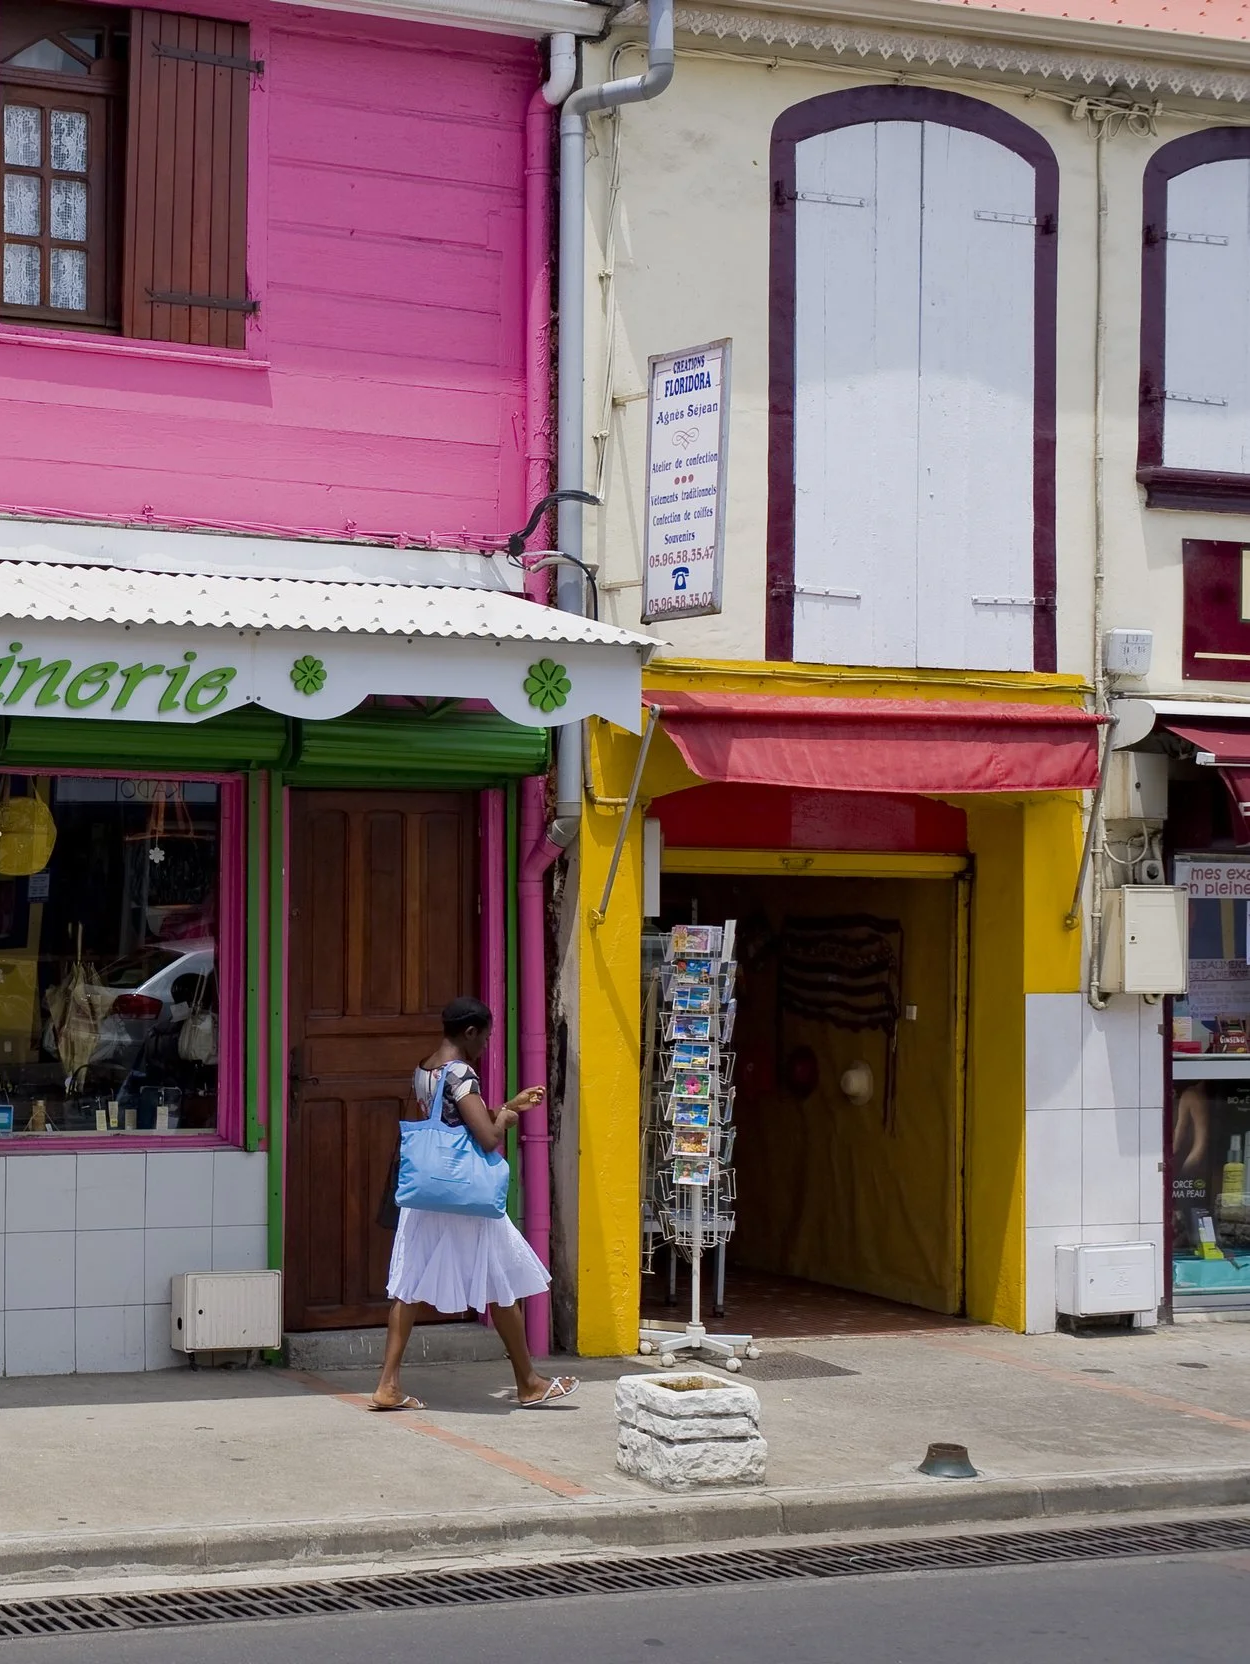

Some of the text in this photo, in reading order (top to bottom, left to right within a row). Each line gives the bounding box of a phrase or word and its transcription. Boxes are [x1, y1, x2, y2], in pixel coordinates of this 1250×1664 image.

[673, 355, 705, 374] CREATIONS
[664, 371, 711, 398] FLORIDORA
[656, 409, 684, 426] Agnès
[652, 451, 718, 474] Atelier de confection
[681, 484, 717, 501] traditionnels
[652, 506, 713, 526] Confection de coiffes
[664, 530, 695, 545] Souvenirs
[649, 545, 715, 569] 05.96.58.35.47
[1191, 867, 1222, 881] mes
[1219, 1034, 1246, 1044] GINSENG
[1171, 1189, 1206, 1199] MA PEAU
